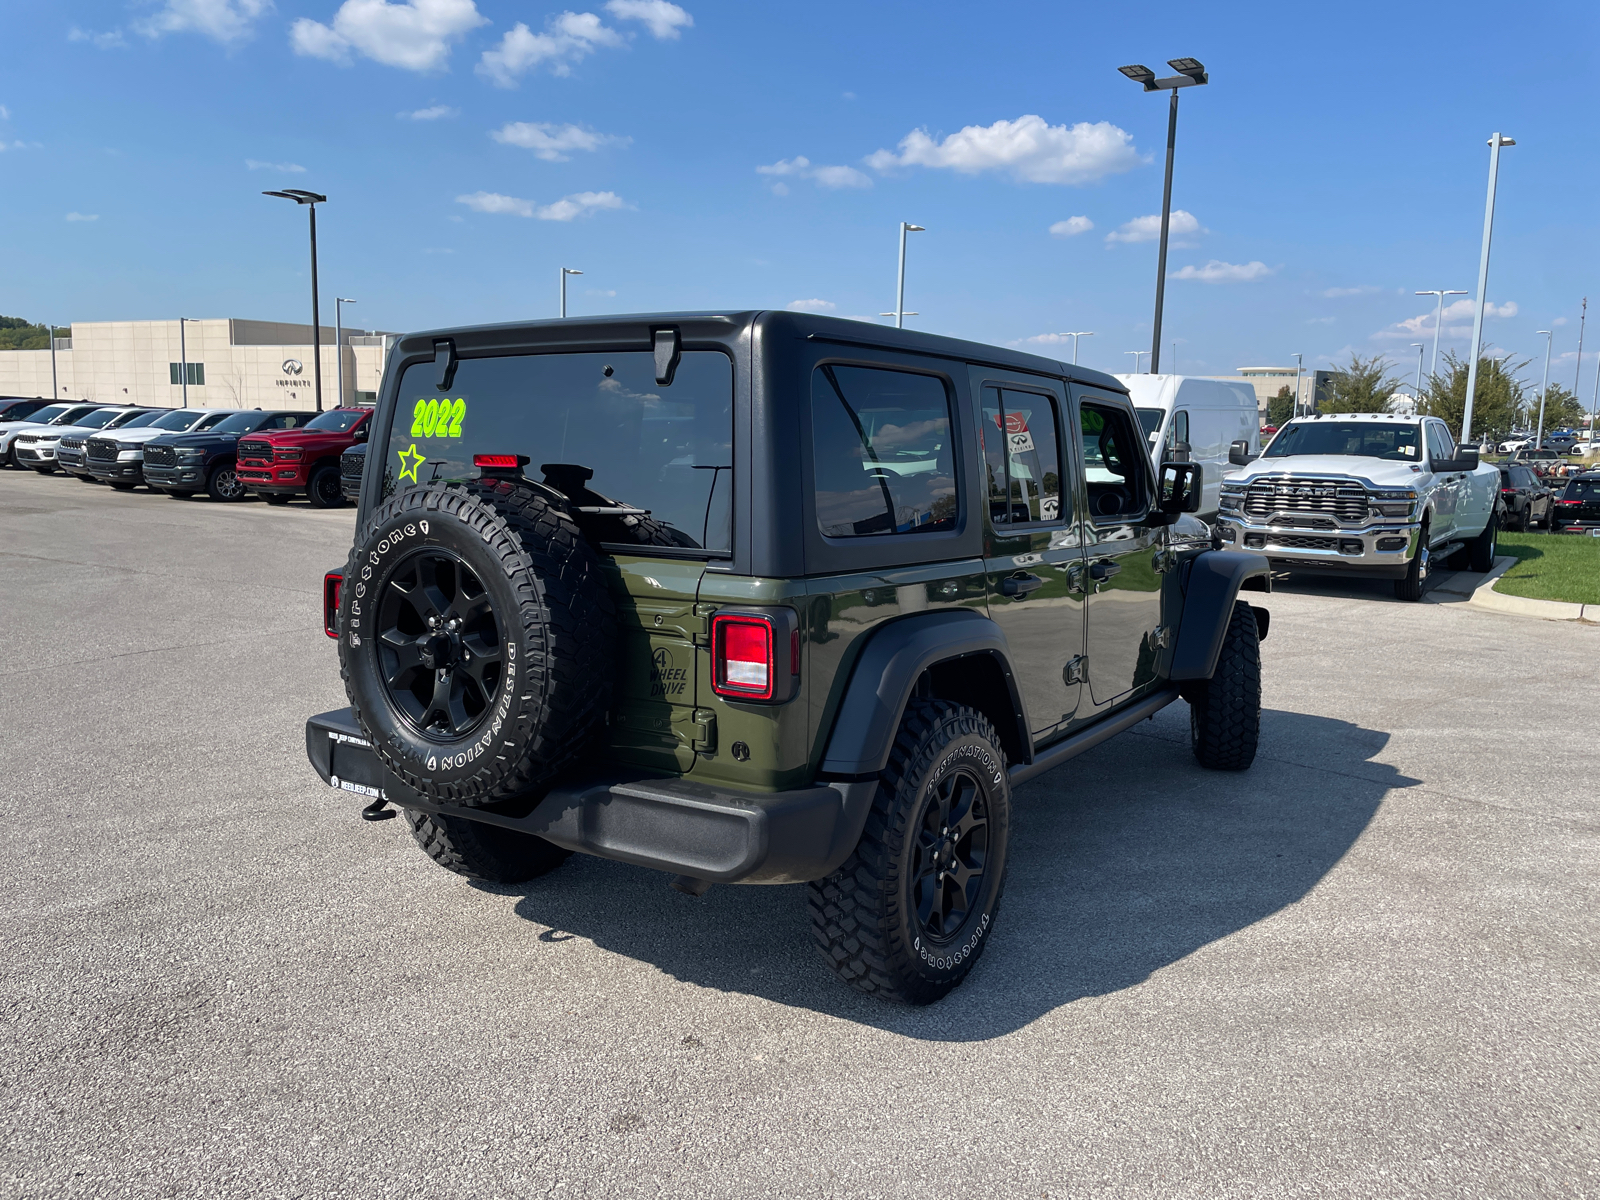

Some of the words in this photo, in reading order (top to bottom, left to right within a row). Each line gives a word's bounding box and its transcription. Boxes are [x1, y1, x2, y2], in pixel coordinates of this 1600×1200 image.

[411, 398, 466, 438] 2022
[1275, 486, 1335, 496] RAM
[349, 523, 416, 648] Firestone
[650, 668, 687, 682] WHEEL
[650, 682, 686, 697] DRIVE
[441, 642, 517, 771] DESTINATION
[927, 744, 998, 795] DESTINATION
[920, 912, 990, 971] Firestone
